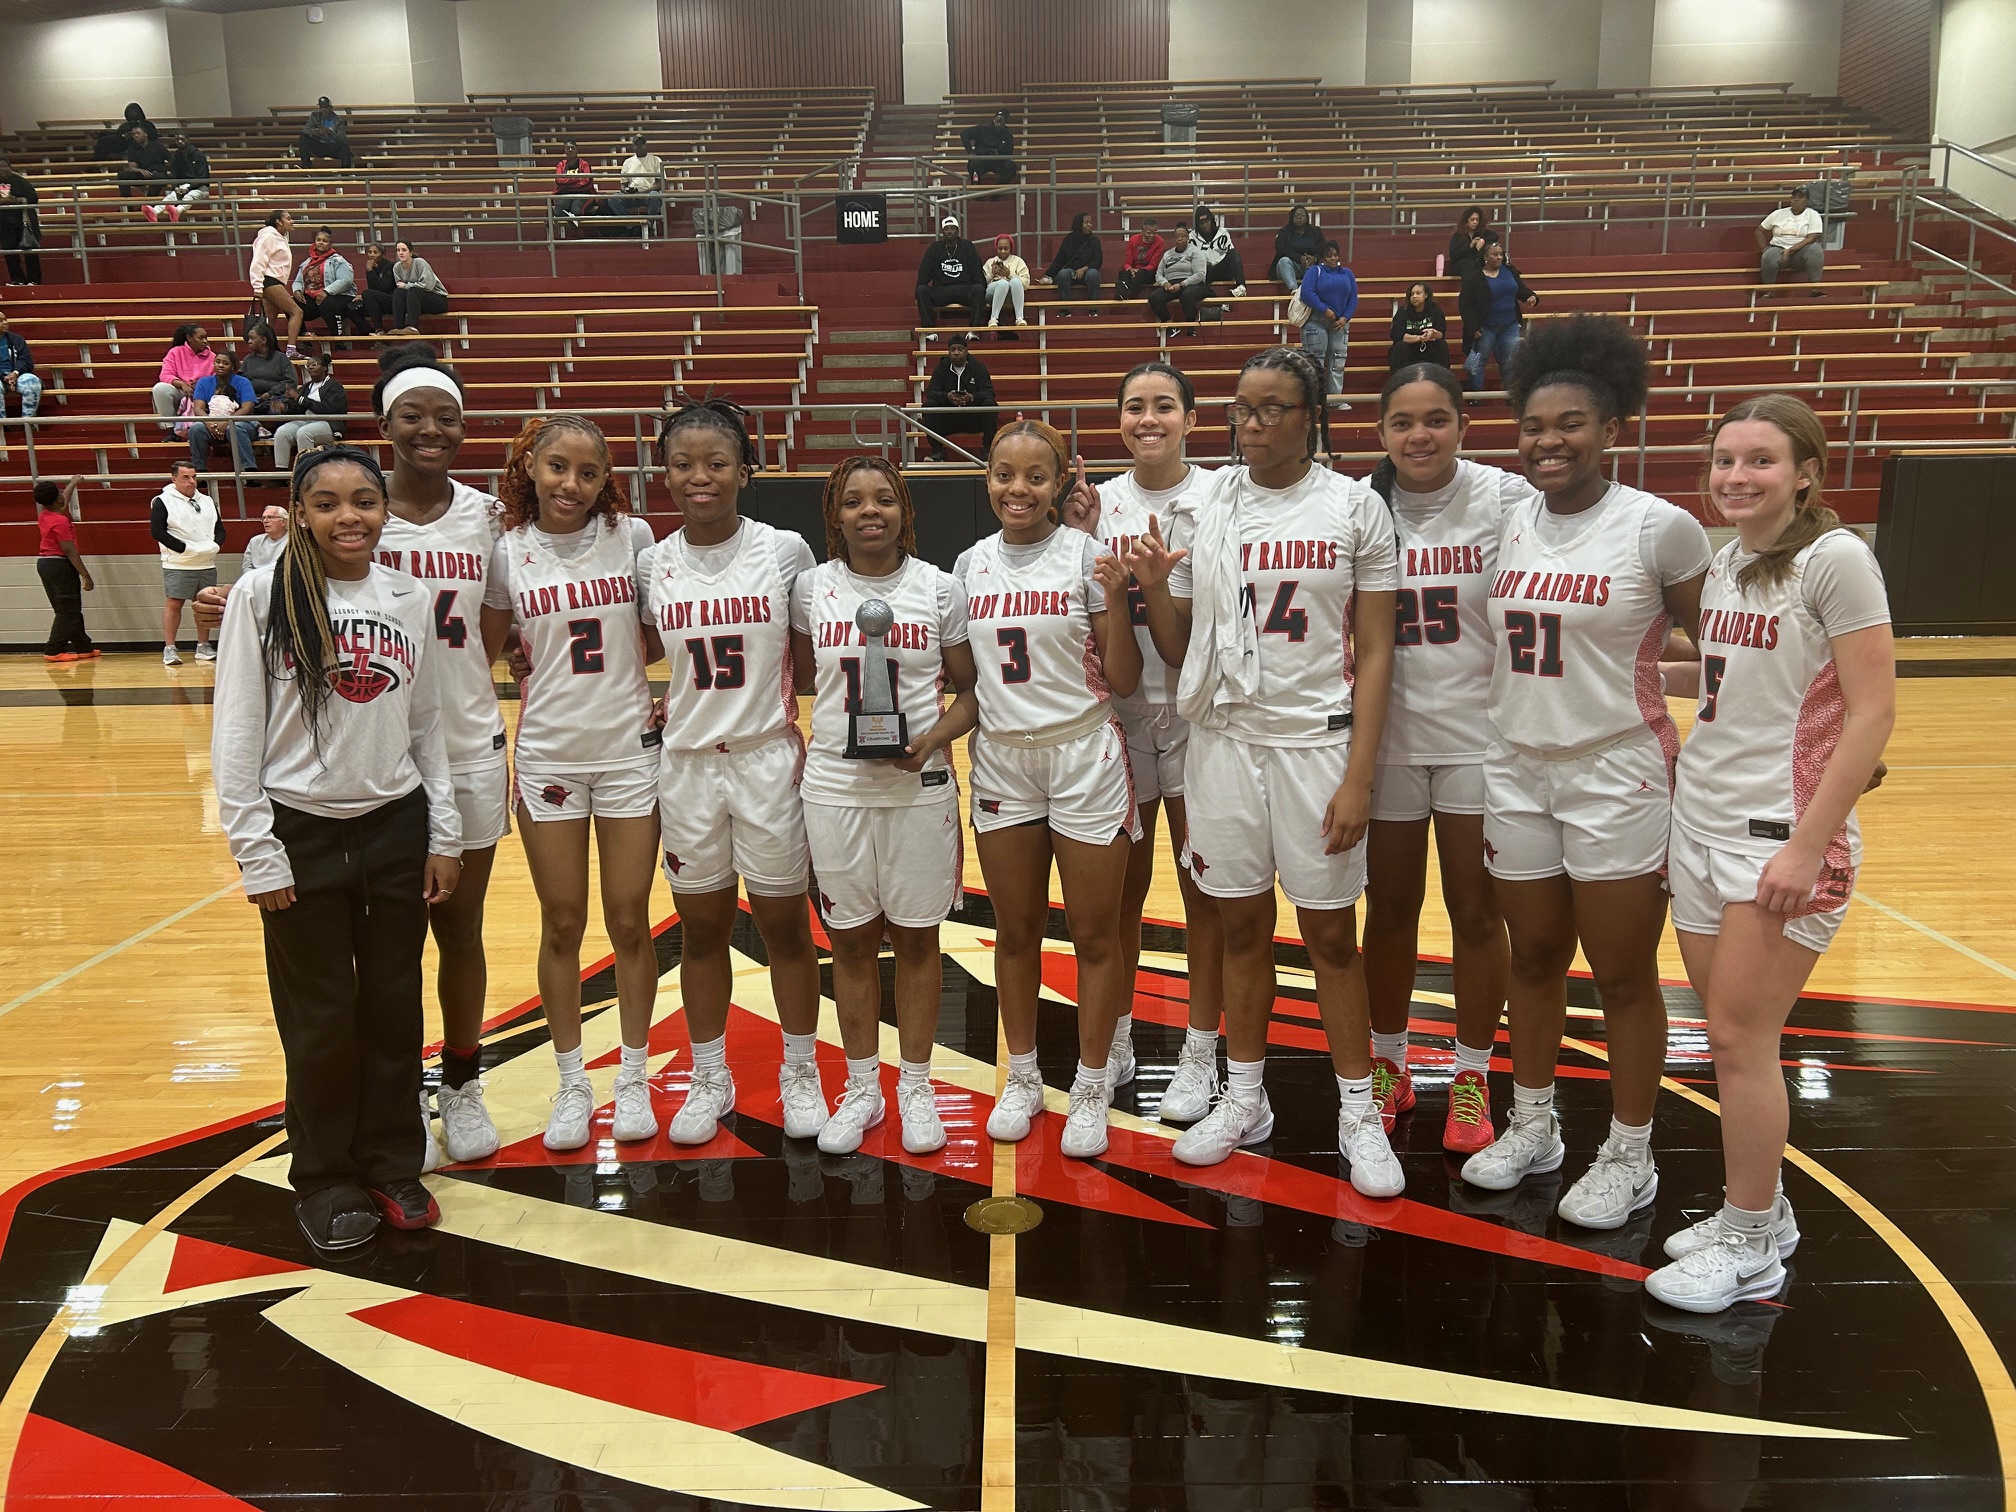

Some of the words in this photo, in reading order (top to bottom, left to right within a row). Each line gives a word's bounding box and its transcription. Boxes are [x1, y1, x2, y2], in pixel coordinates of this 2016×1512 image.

[844, 210, 879, 228] HOME
[410, 550, 483, 582] RAIDERS
[1258, 540, 1337, 570] RAIDERS
[1406, 545, 1483, 577] RAIDERS
[519, 585, 561, 619] LADY
[565, 575, 635, 610] RAIDERS
[967, 593, 999, 621] LADY
[1002, 590, 1070, 618] RAIDERS
[1488, 570, 1526, 599] LADY
[1523, 572, 1611, 607] RAIDERS
[434, 590, 467, 649] 4
[660, 601, 694, 632] LADY
[699, 595, 771, 627] RAIDERS
[1395, 586, 1460, 646] 25
[1710, 609, 1780, 651] RAIDERS
[567, 617, 605, 675] 2
[818, 621, 854, 649] LADY
[1504, 609, 1564, 678] 21
[349, 648, 375, 677] TL
[684, 634, 746, 691] 15
[996, 626, 1032, 685] 3
[1776, 827, 1785, 836] M
